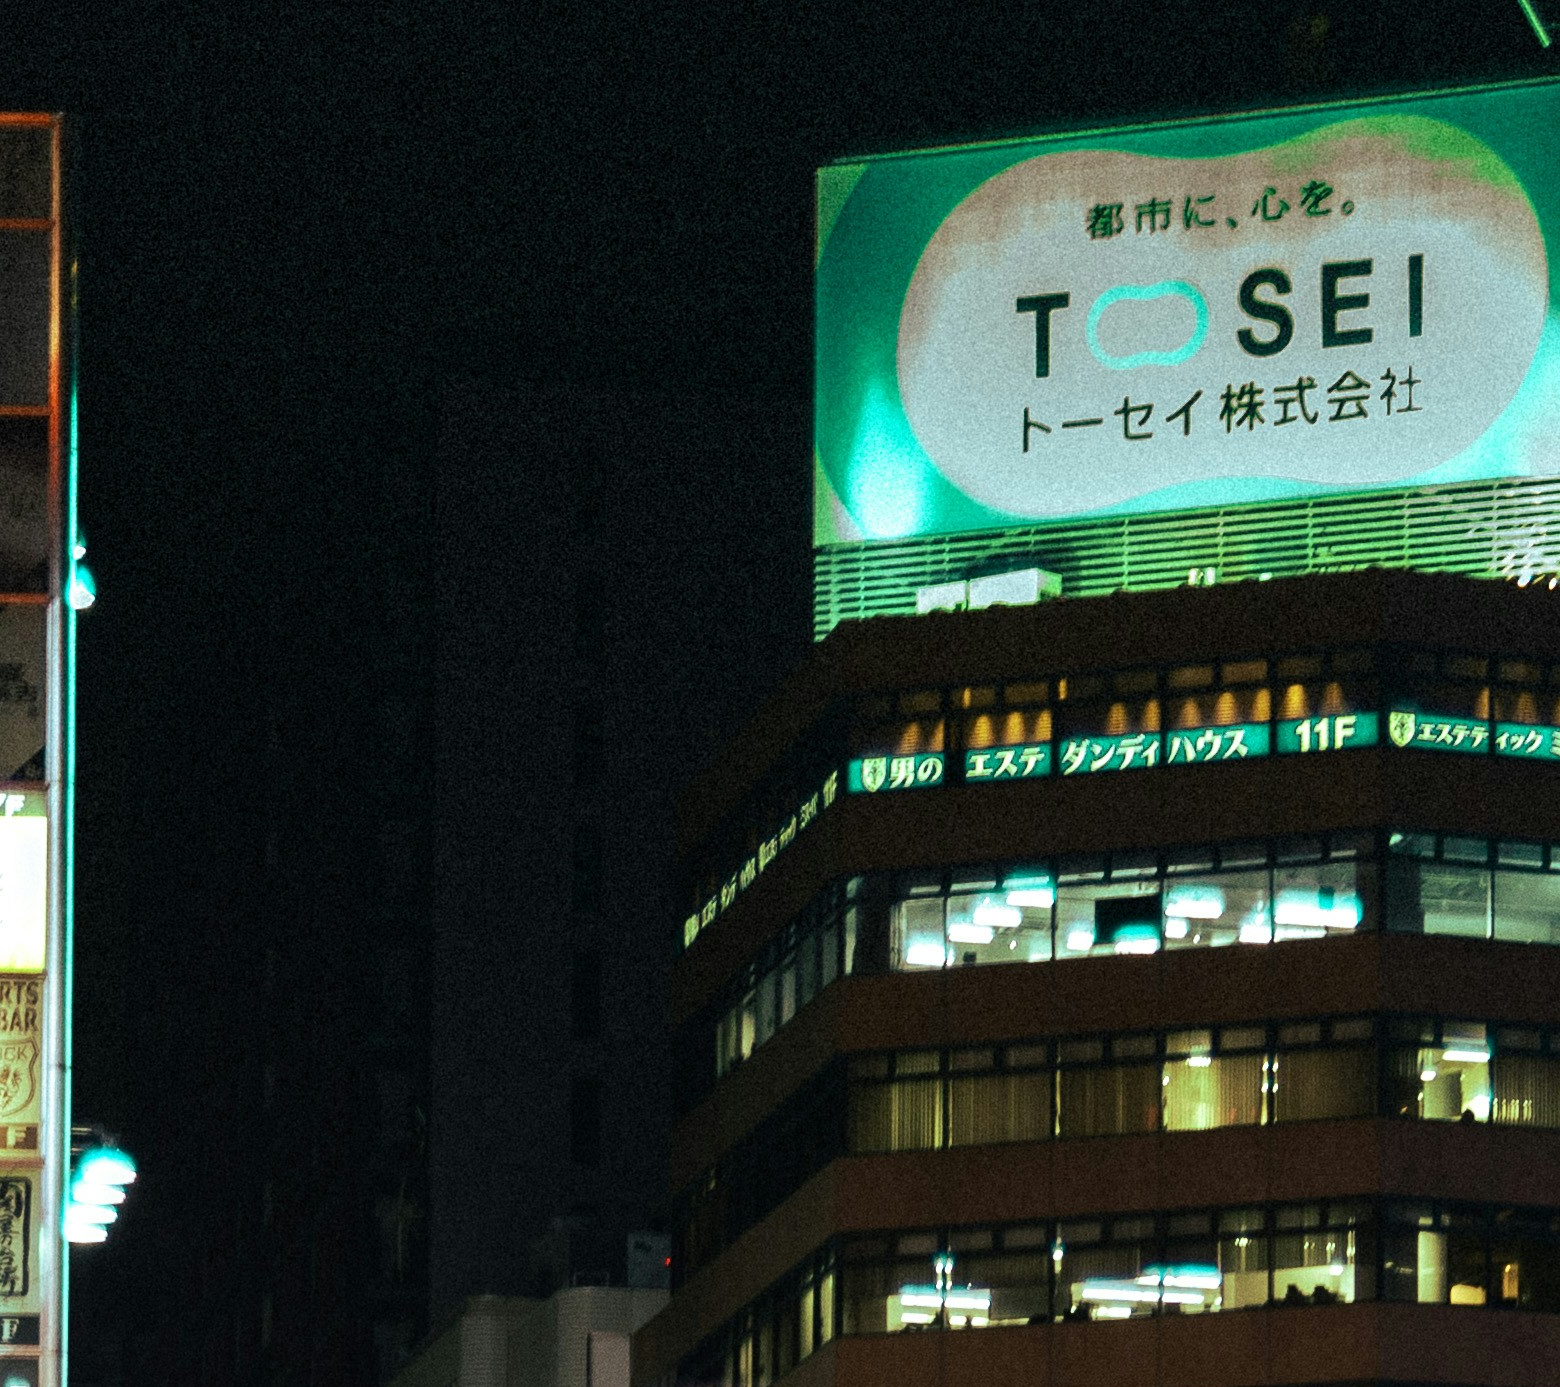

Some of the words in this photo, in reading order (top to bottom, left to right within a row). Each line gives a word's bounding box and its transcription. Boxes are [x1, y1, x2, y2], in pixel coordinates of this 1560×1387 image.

[1084, 180, 1356, 240] 都市に、心を。
[1021, 366, 1424, 453] トーセイ株式会社
[889, 754, 942, 789] 男の
[965, 747, 1046, 780] エステ
[1060, 728, 1248, 777] ダンディハウス
[1295, 715, 1357, 752] 11F
[1417, 722, 1544, 754] エステティック
